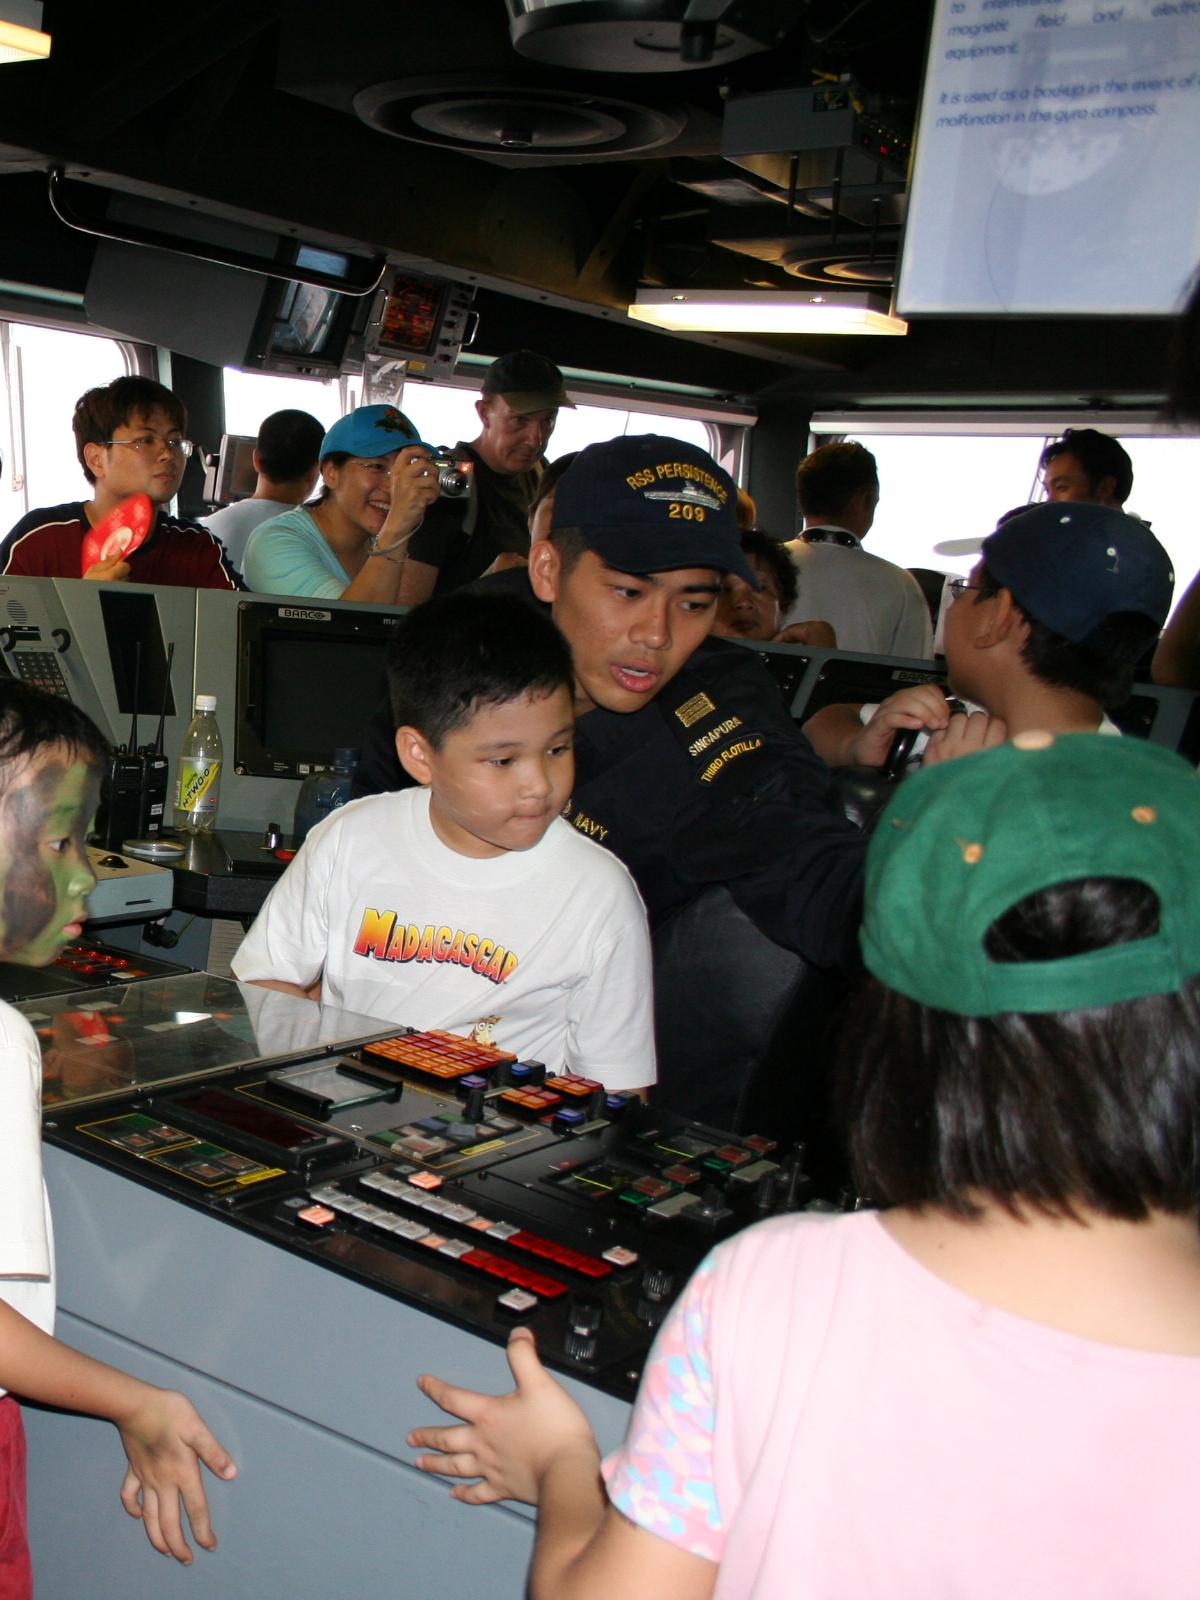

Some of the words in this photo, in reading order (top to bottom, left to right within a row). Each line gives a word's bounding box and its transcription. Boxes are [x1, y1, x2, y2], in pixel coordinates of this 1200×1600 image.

[1092, 7, 1124, 23] and
[964, 88, 999, 103] used
[1000, 90, 1018, 101] as
[1087, 83, 1101, 95] in
[1104, 79, 1128, 93] the
[936, 111, 1010, 128] malfunction
[1013, 111, 1026, 122] in
[1029, 108, 1052, 122] the
[1054, 110, 1088, 125] gyro
[626, 468, 656, 491] RSS
[656, 462, 728, 504] PERSISTENCE
[668, 503, 705, 522] 209
[284, 608, 326, 620] BARCO
[688, 716, 742, 757] SINGAPURA
[701, 758, 724, 782] THIRD
[721, 739, 762, 762] FLOTILLA
[573, 811, 609, 841] NAVY
